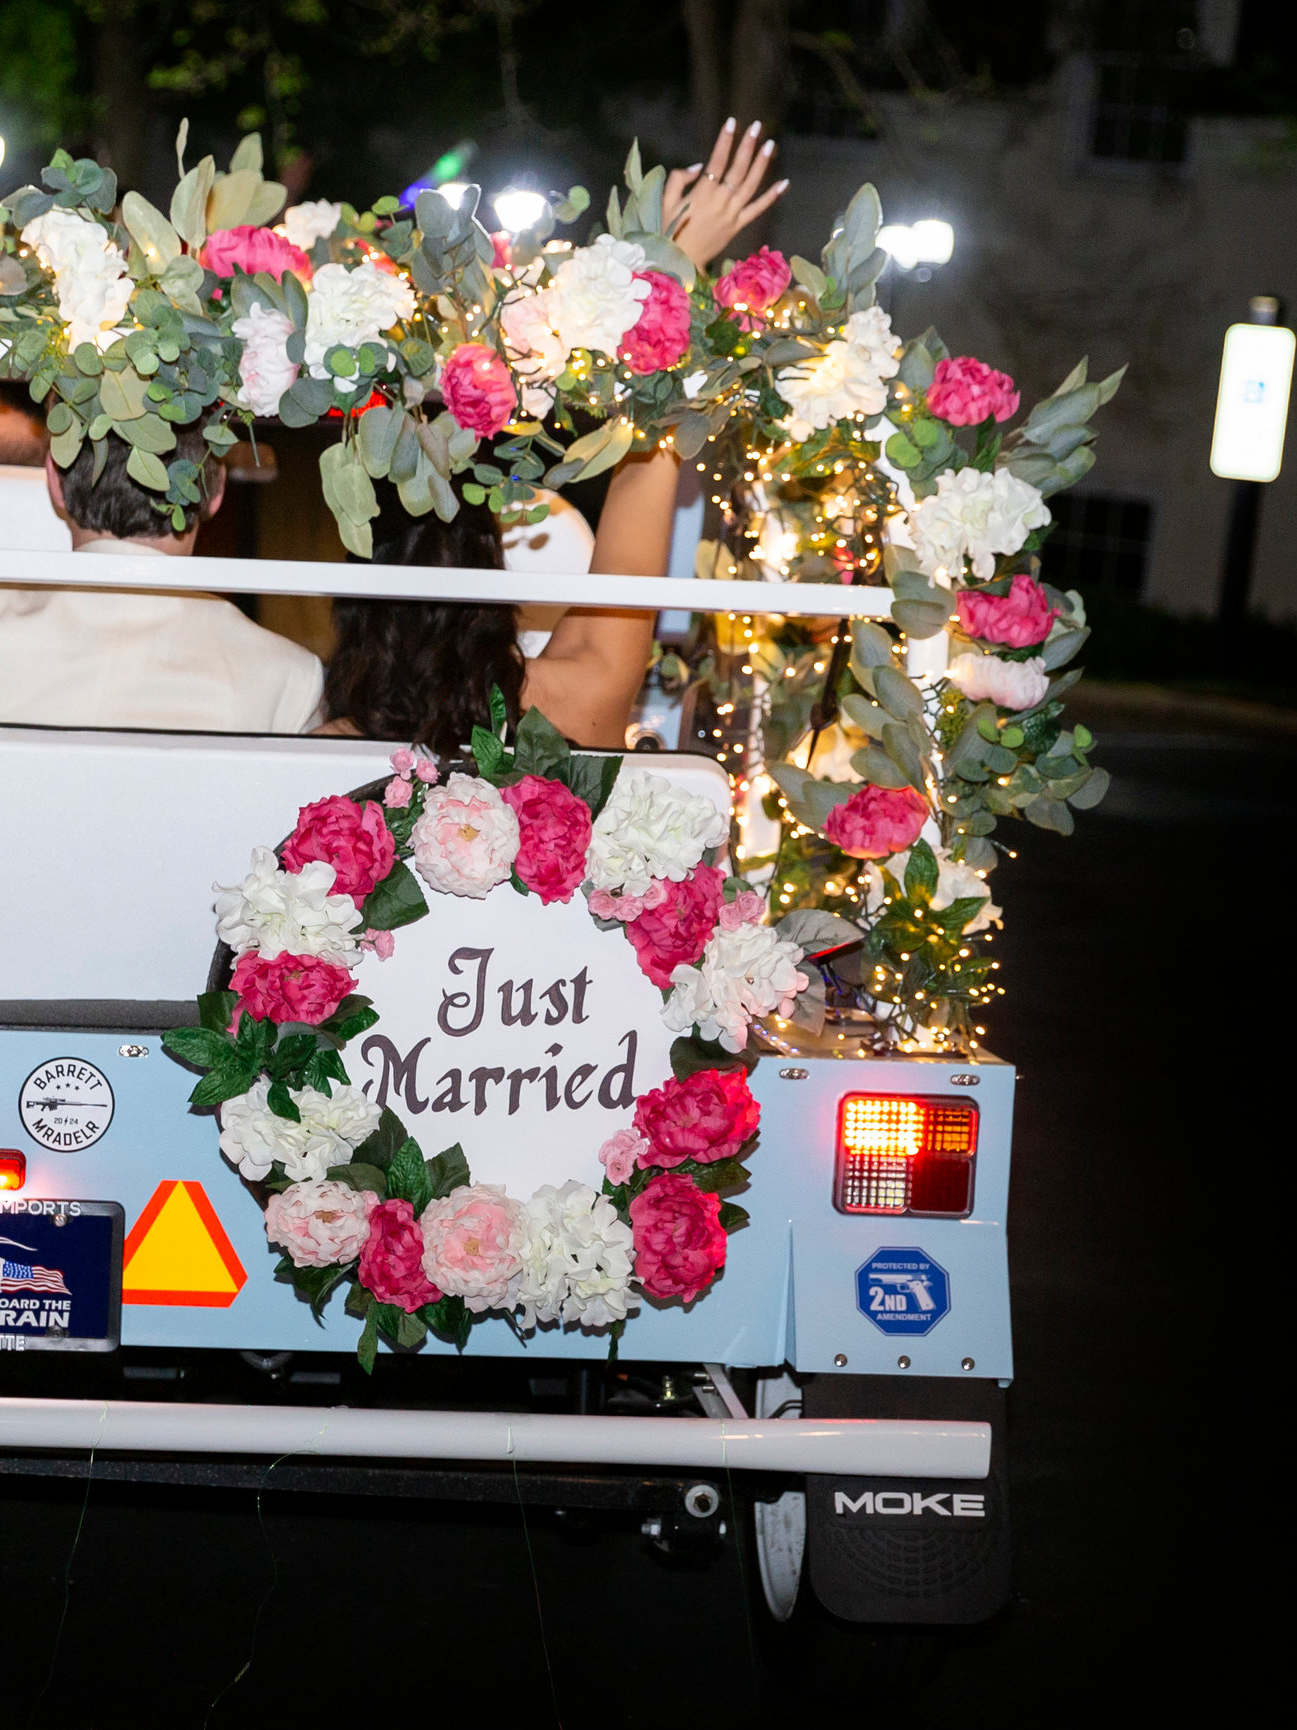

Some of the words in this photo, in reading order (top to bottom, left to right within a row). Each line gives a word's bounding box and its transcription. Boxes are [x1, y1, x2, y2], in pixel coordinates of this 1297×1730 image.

[437, 946, 593, 1037] Just
[33, 1063, 103, 1091] BARRETT
[360, 1029, 639, 1116] Married
[32, 1118, 100, 1146] MRADELR
[53, 1117, 63, 1125] 20
[871, 1262, 919, 1270] PROTECTED
[43, 1299, 71, 1310] THE
[868, 1286, 907, 1311] 2ND
[876, 1313, 932, 1321] AMENDMENT
[834, 1491, 986, 1517] MOKE
